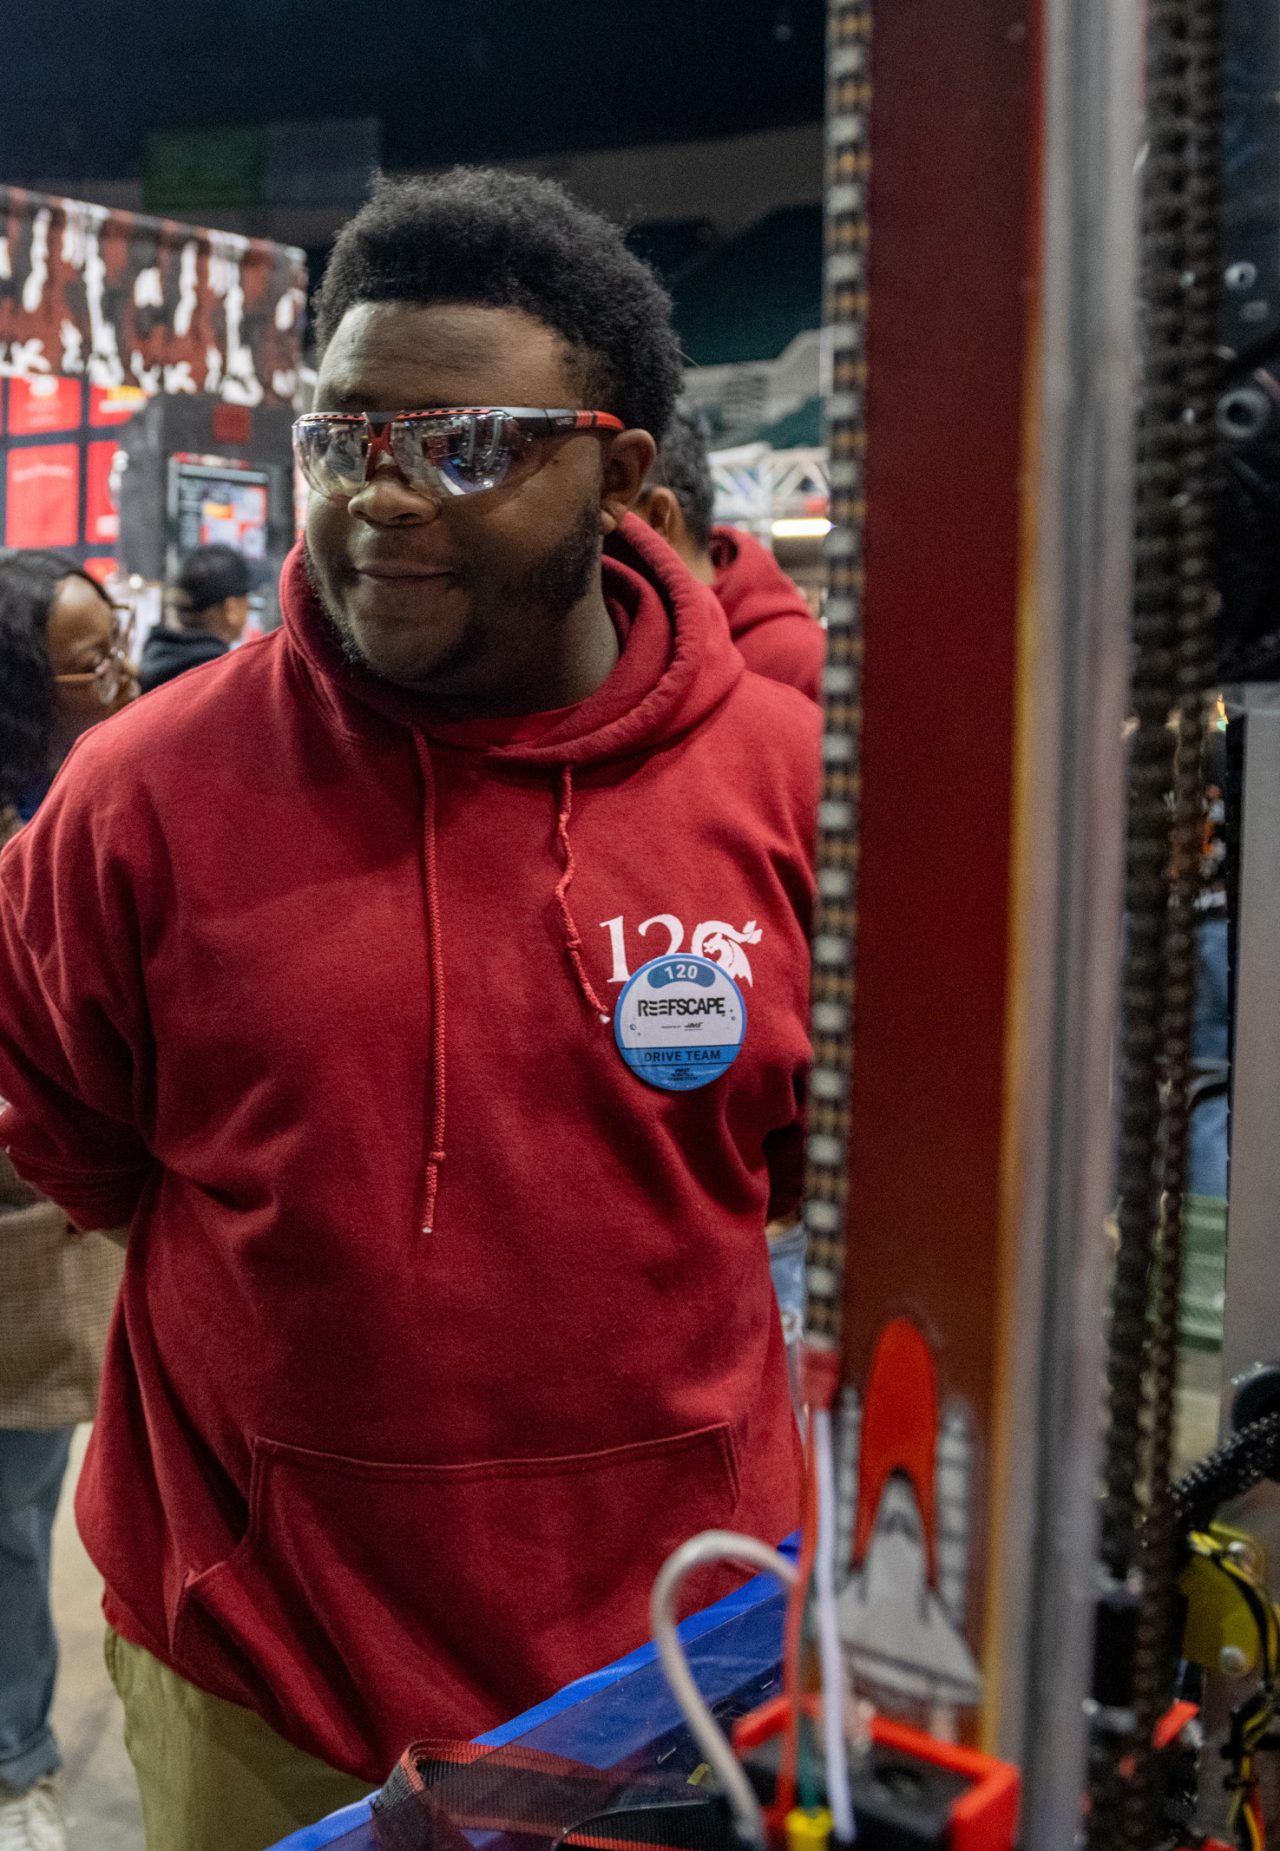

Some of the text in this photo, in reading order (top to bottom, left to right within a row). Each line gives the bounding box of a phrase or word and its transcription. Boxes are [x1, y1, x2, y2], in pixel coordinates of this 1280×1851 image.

[664, 963, 698, 980] 120
[637, 997, 726, 1017] REEFSCAPE
[643, 1049, 721, 1063] DRIVE TEAM
